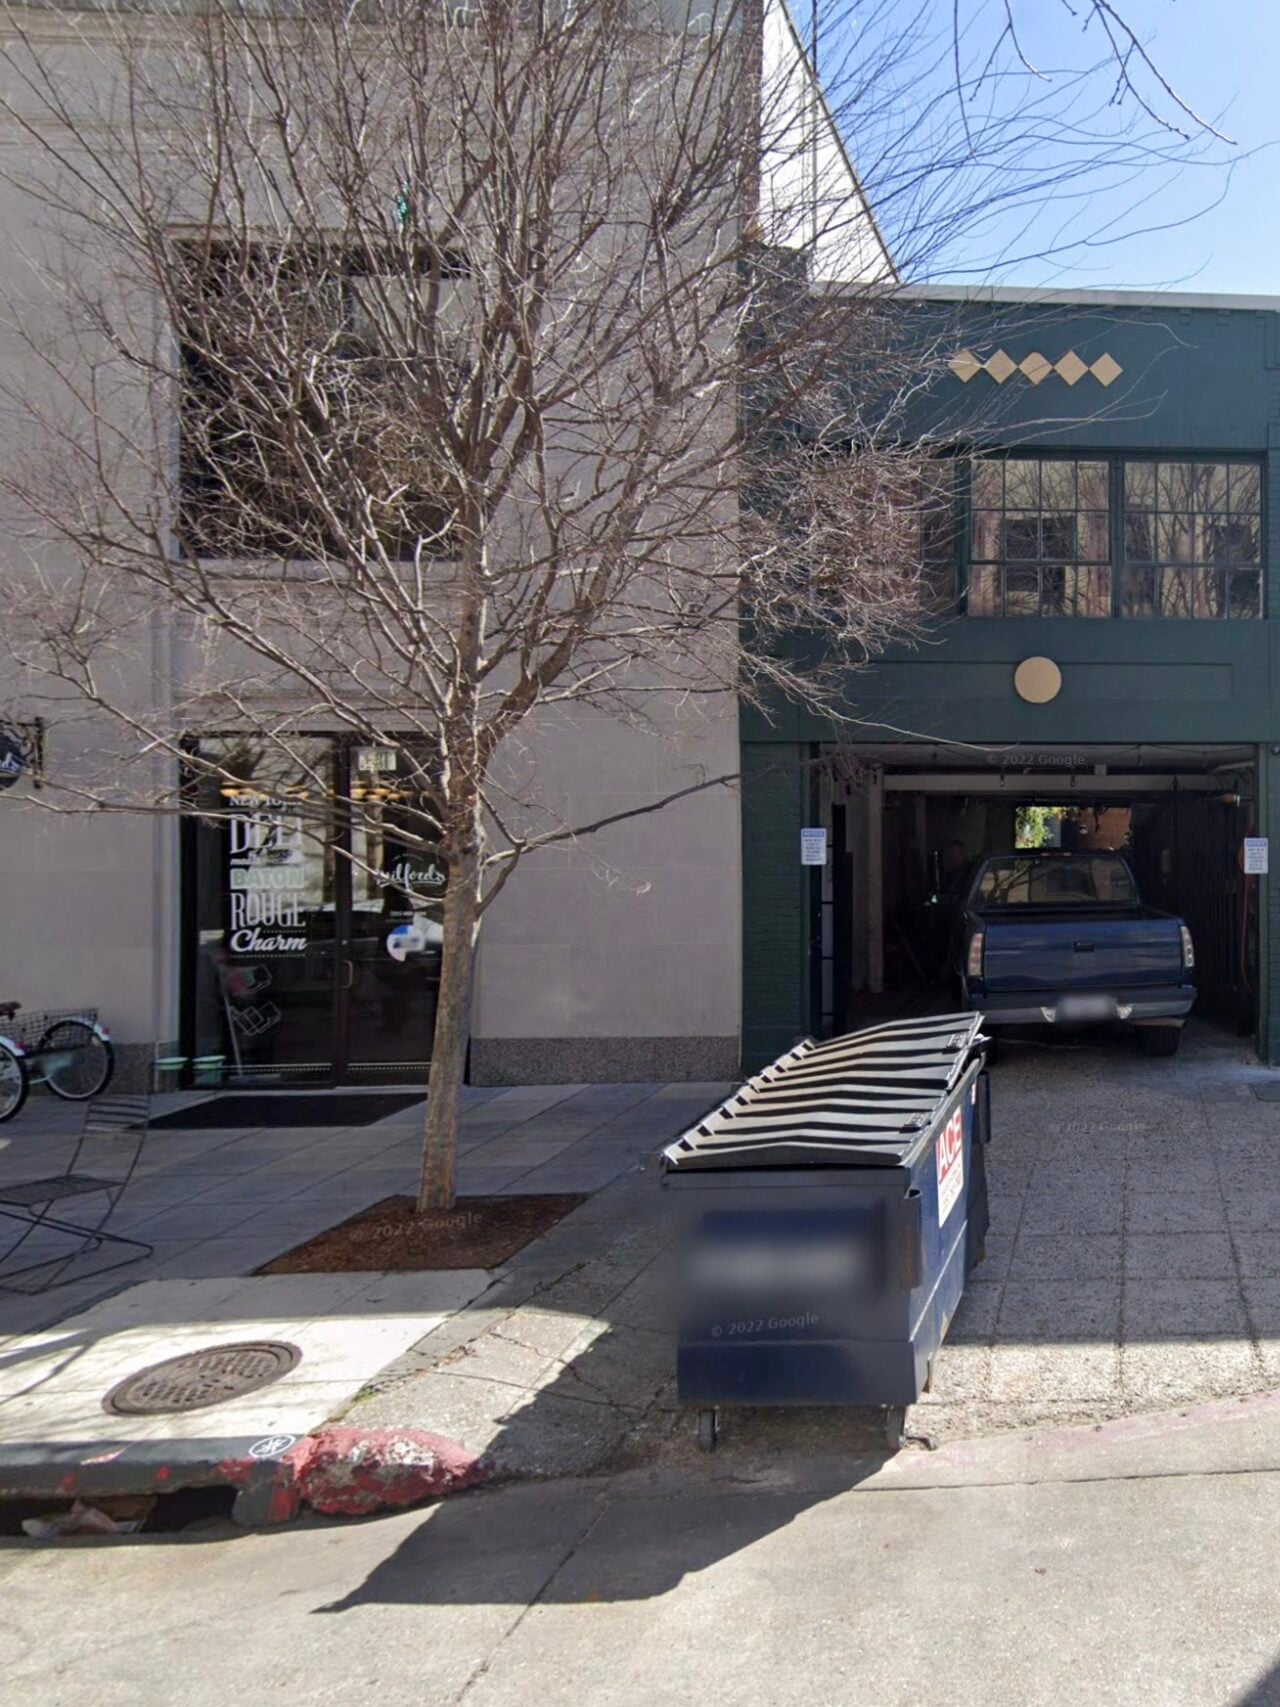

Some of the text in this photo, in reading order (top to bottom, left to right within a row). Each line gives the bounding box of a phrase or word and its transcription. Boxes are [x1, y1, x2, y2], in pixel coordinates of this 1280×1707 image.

[229, 813, 303, 854] DELI
[231, 868, 304, 890] BATON
[230, 892, 307, 931] ROUGE
[230, 926, 308, 952] Charm
